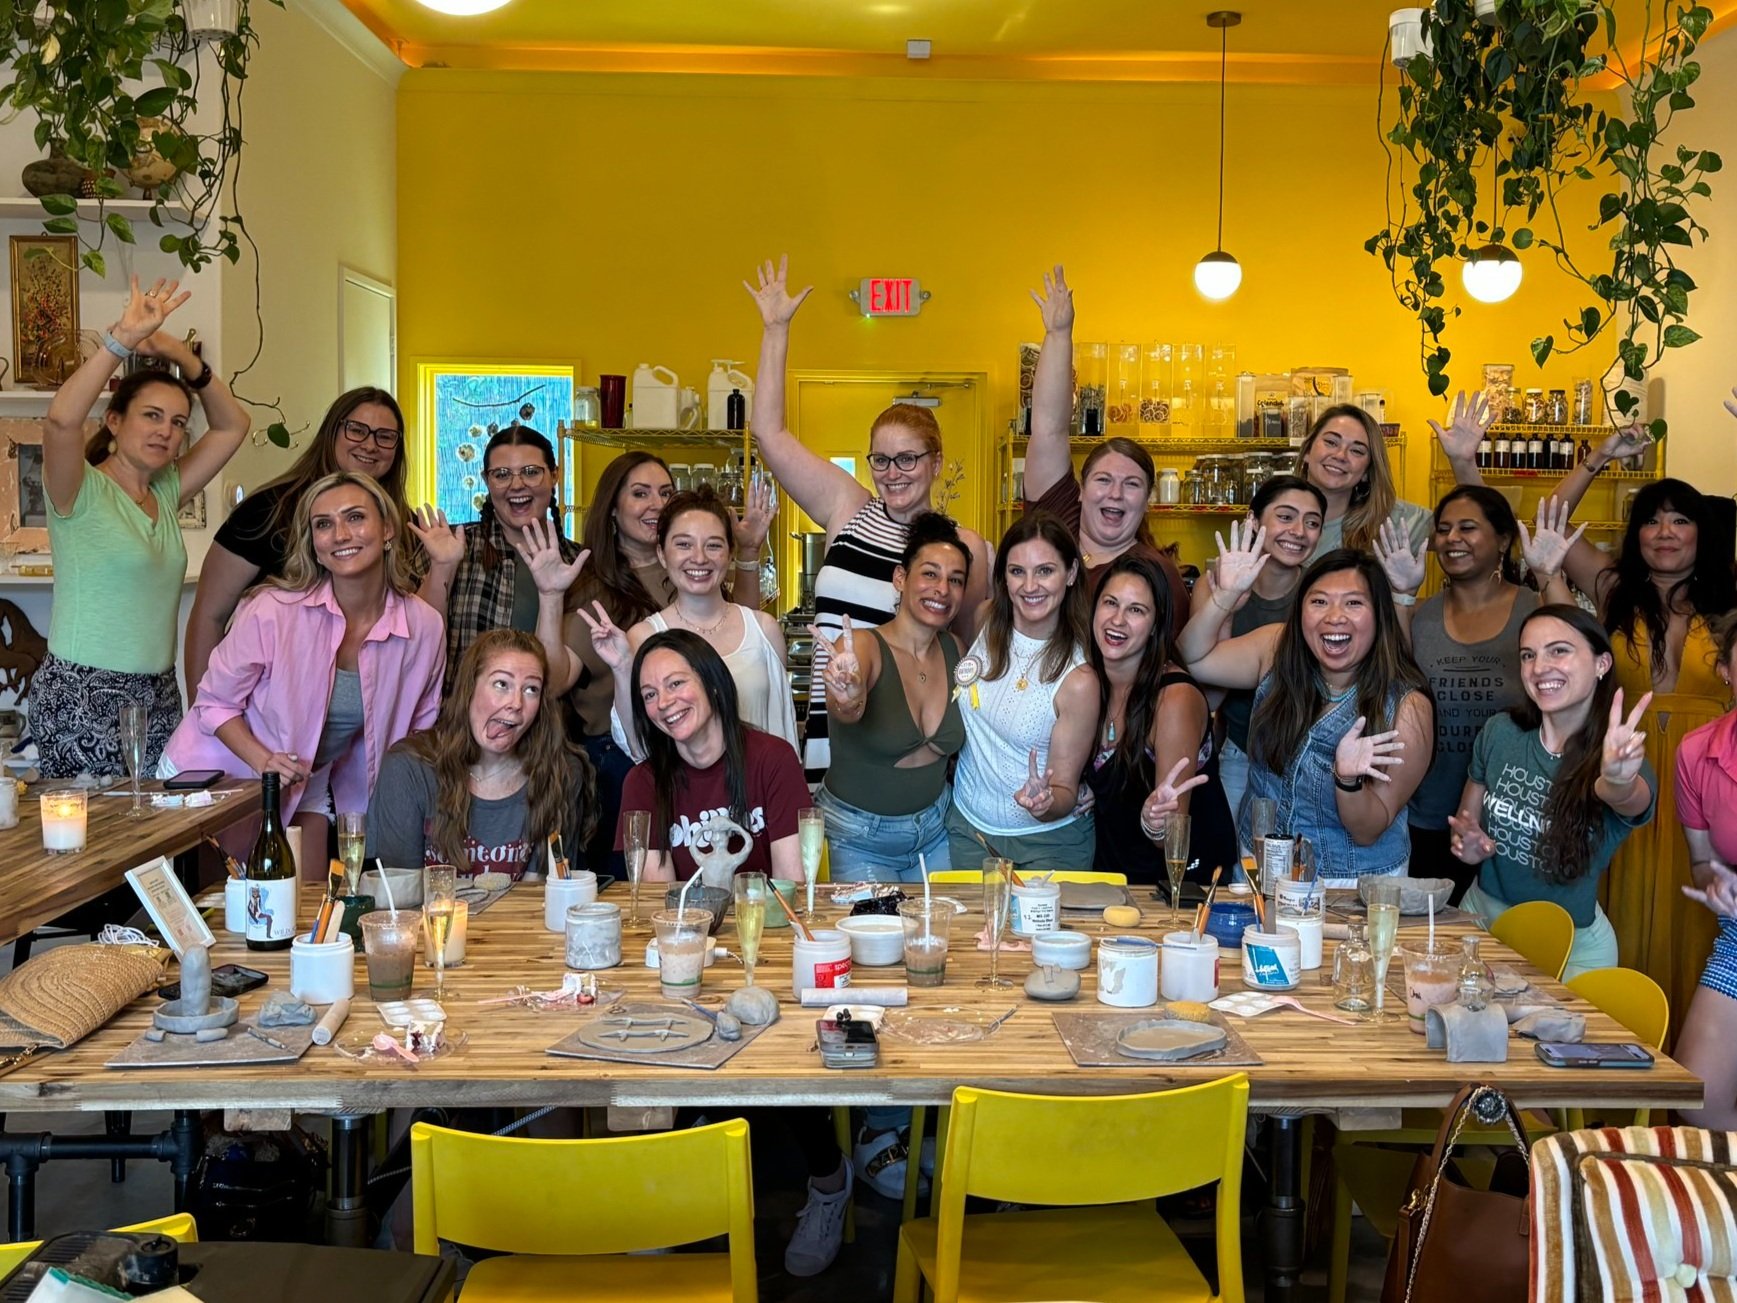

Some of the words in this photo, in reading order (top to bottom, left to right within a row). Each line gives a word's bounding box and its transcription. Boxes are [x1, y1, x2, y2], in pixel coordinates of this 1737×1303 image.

[870, 279, 912, 312] EXIT
[1437, 656, 1466, 665] KEEP
[1472, 655, 1500, 664] YOUR
[1428, 677, 1504, 688] FRIENDS
[1437, 690, 1494, 701] CLOSE
[1466, 708, 1496, 717] YOUR
[1502, 763, 1553, 793] HOUST
[1496, 777, 1549, 808] HOUST
[1483, 791, 1551, 833] WELLN
